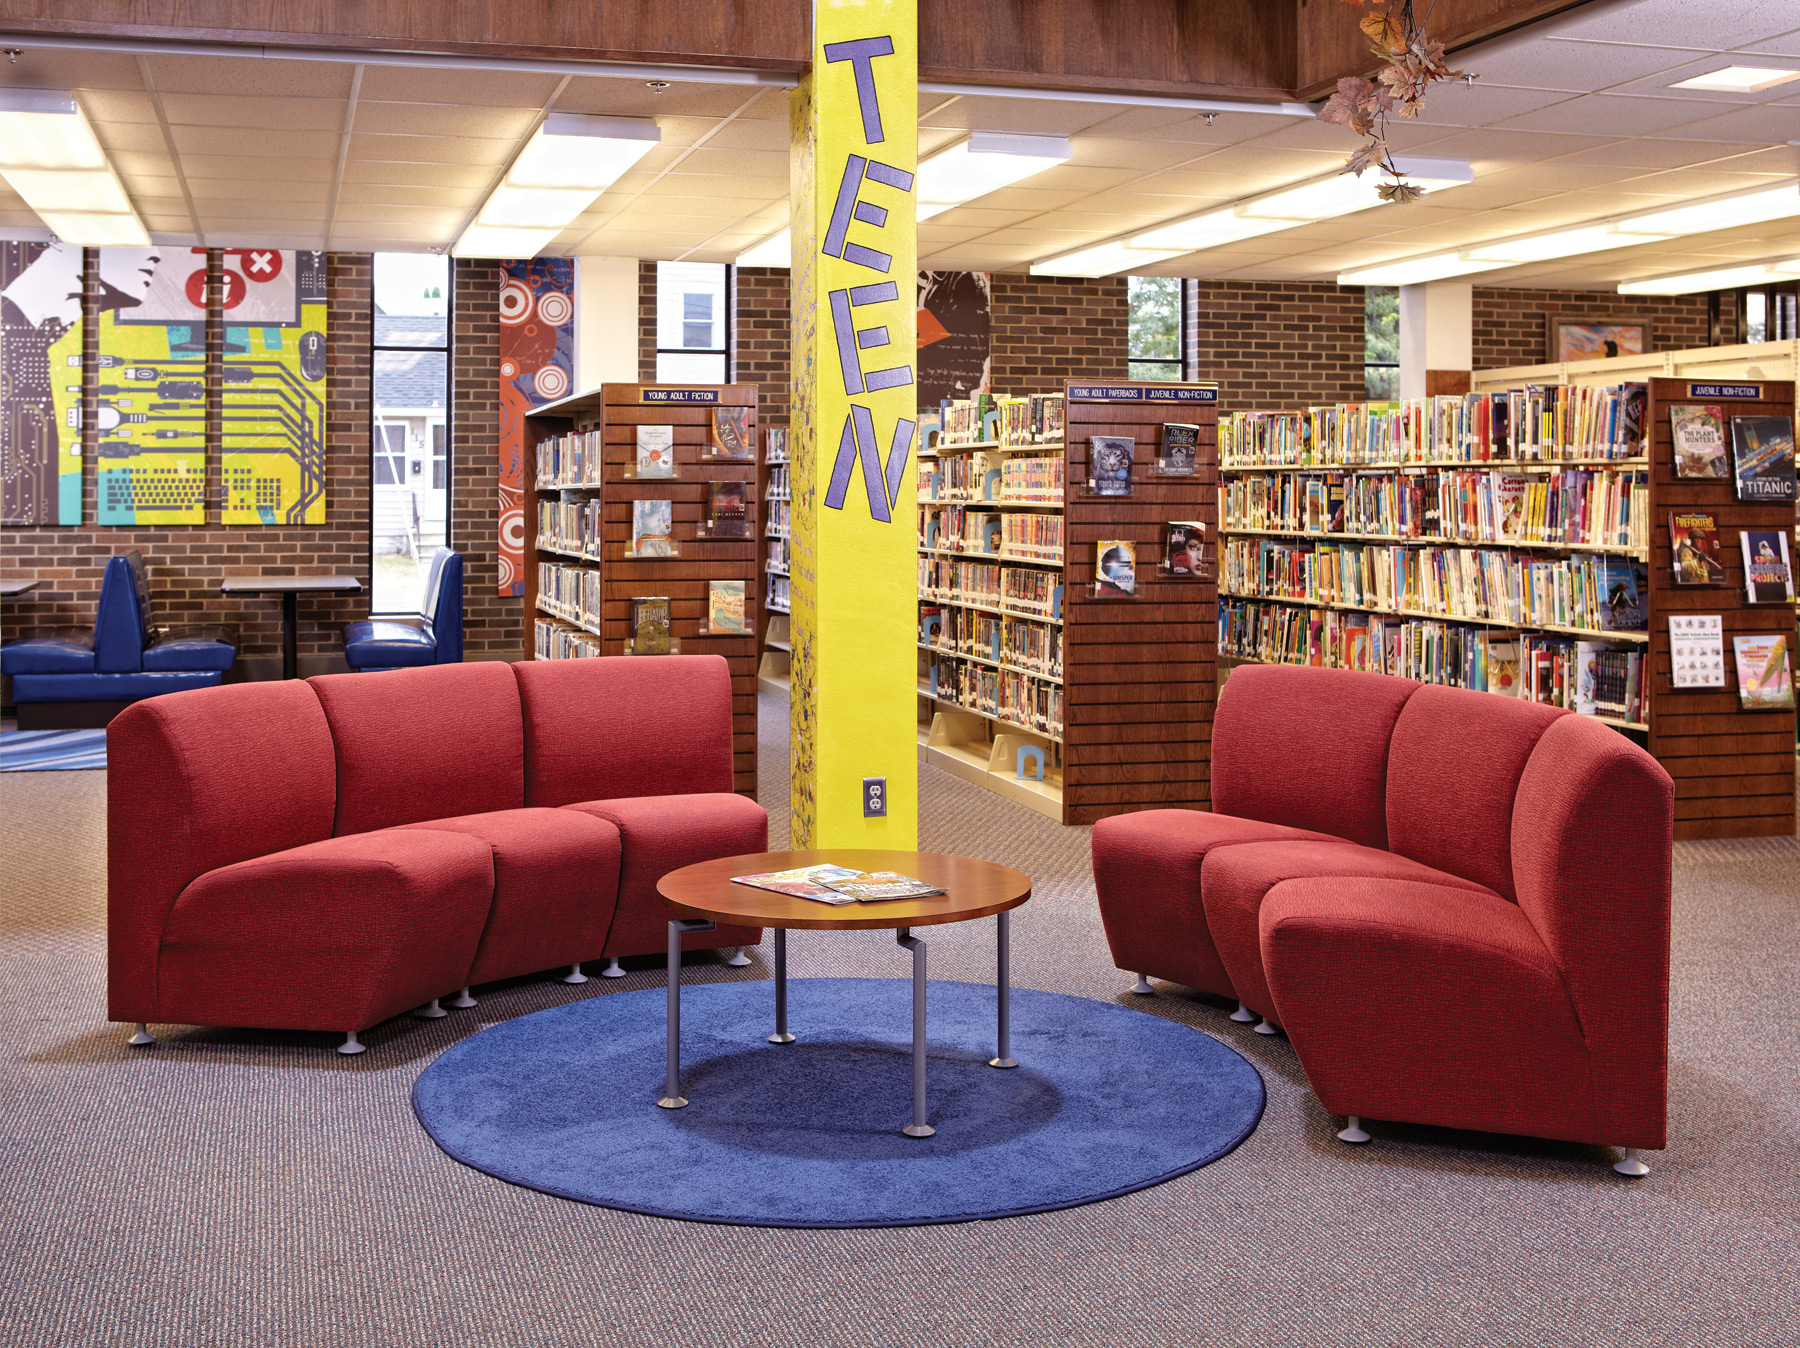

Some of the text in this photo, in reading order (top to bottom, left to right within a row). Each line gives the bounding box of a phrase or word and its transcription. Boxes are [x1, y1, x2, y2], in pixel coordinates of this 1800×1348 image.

[822, 35, 916, 523] TEEN
[648, 391, 713, 400] YOUNG ADULT FICTION
[1073, 388, 1138, 398] YOUNG ADULT PAPERBACKS
[1149, 389, 1213, 399] JUVENILE NON-FICTION
[1695, 386, 1756, 397] JUVENILE NON-FICTION
[1170, 429, 1195, 437] ALEX
[1168, 436, 1195, 445] RIDER
[1745, 481, 1792, 494] TITANIC
[1675, 516, 1714, 528] FIREFIGHTERS
[1750, 573, 1790, 583] PROJECTS
